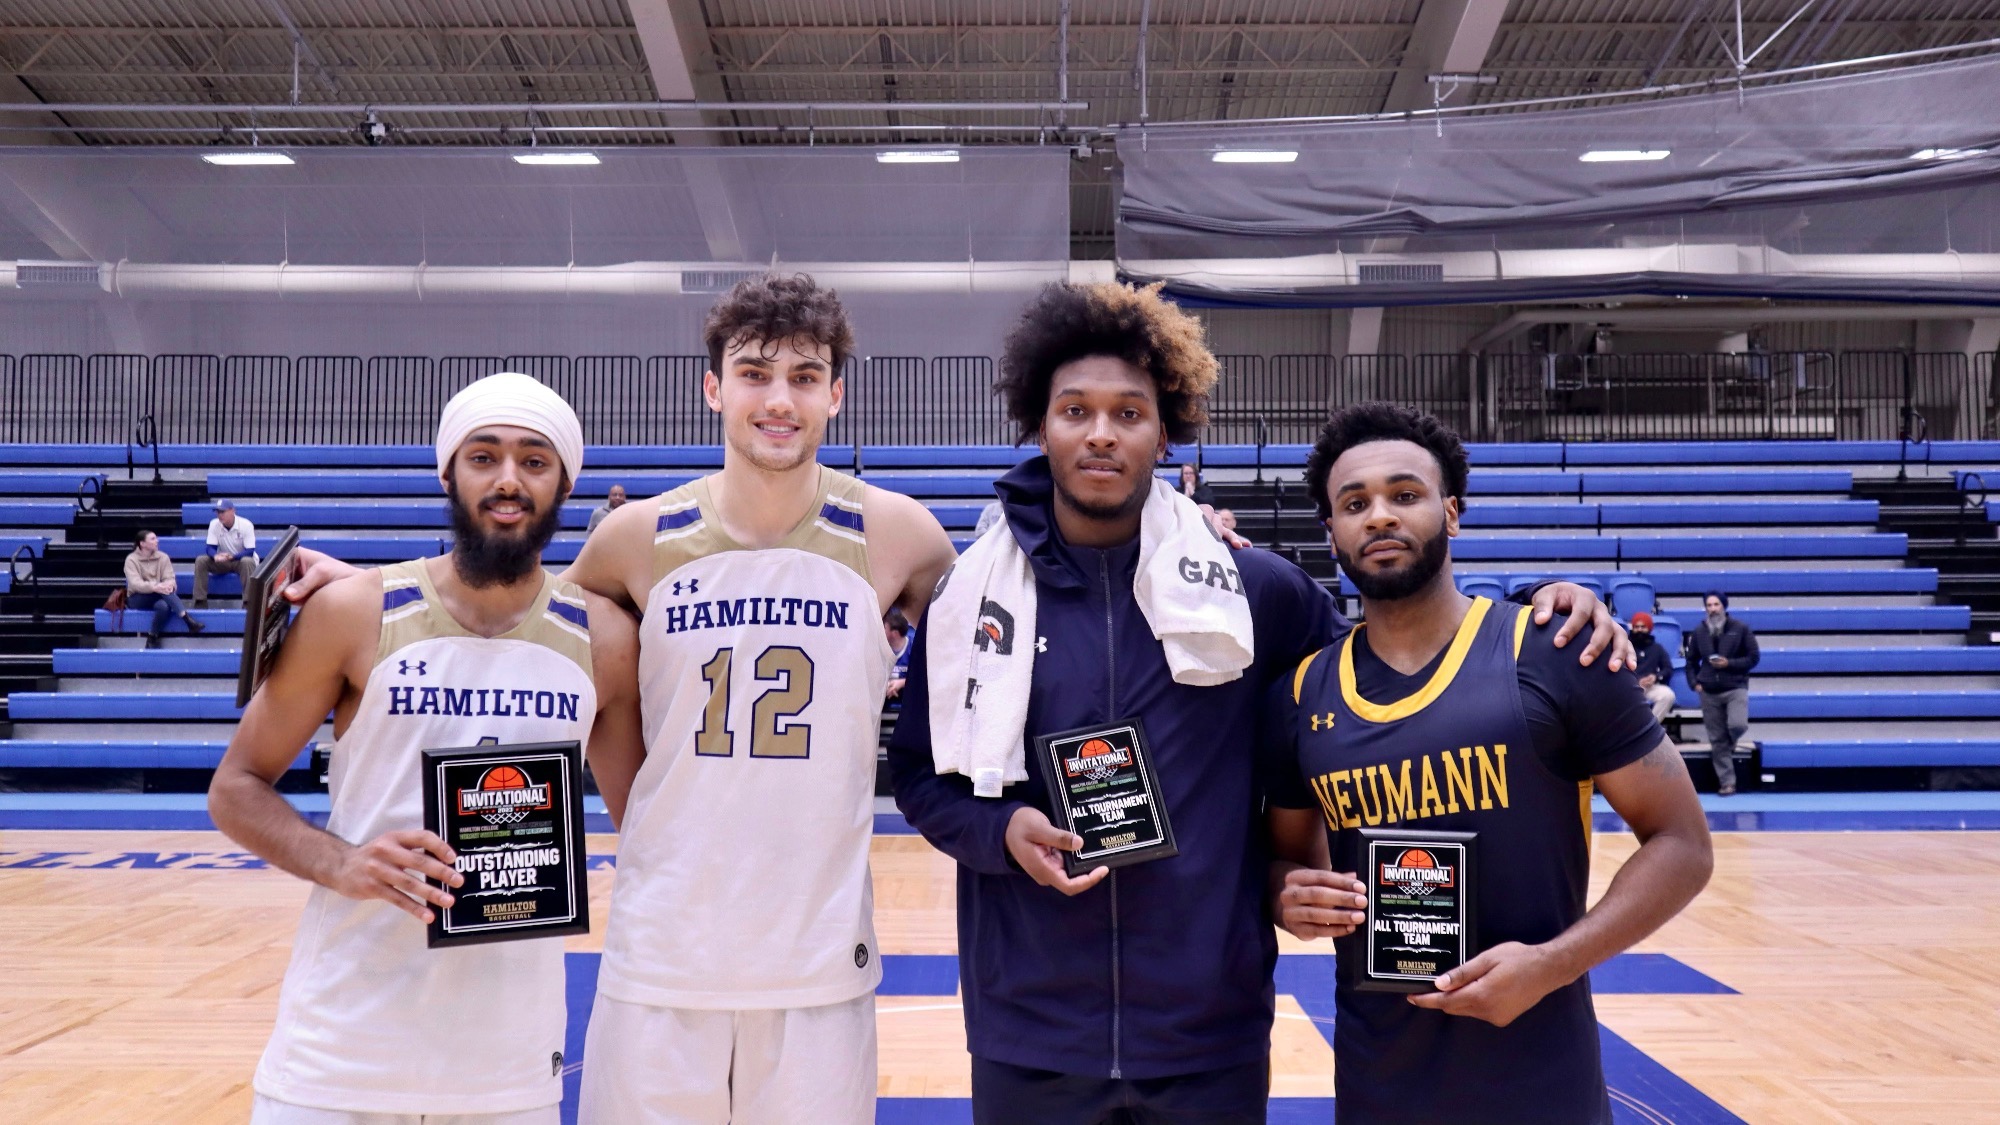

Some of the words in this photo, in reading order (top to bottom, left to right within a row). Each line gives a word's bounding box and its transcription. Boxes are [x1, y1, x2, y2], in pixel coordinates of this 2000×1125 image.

[666, 597, 849, 634] HAMILTON
[388, 686, 580, 722] HAMILTON
[695, 645, 815, 759] 12
[1068, 751, 1128, 772] INVITATIONAL
[1311, 744, 1509, 831] NEUMANN
[463, 788, 546, 808] INVITATIONAL
[1072, 806, 1088, 819] ALL
[1088, 793, 1148, 815] TOURNAMENT
[1100, 809, 1125, 823] TEAM
[1100, 831, 1136, 846] HAMILTON
[455, 848, 560, 873] OUTSTANDING
[480, 868, 537, 889] PLAYER
[1384, 867, 1450, 882] INVITATIONAL
[483, 900, 537, 914] HAMILTON
[489, 913, 531, 922] BASKETBALL
[1374, 919, 1391, 932] ALL
[1393, 920, 1460, 936] TOURNAMENT
[1403, 932, 1431, 946] TEAM
[1397, 960, 1436, 970] HAMILTON
